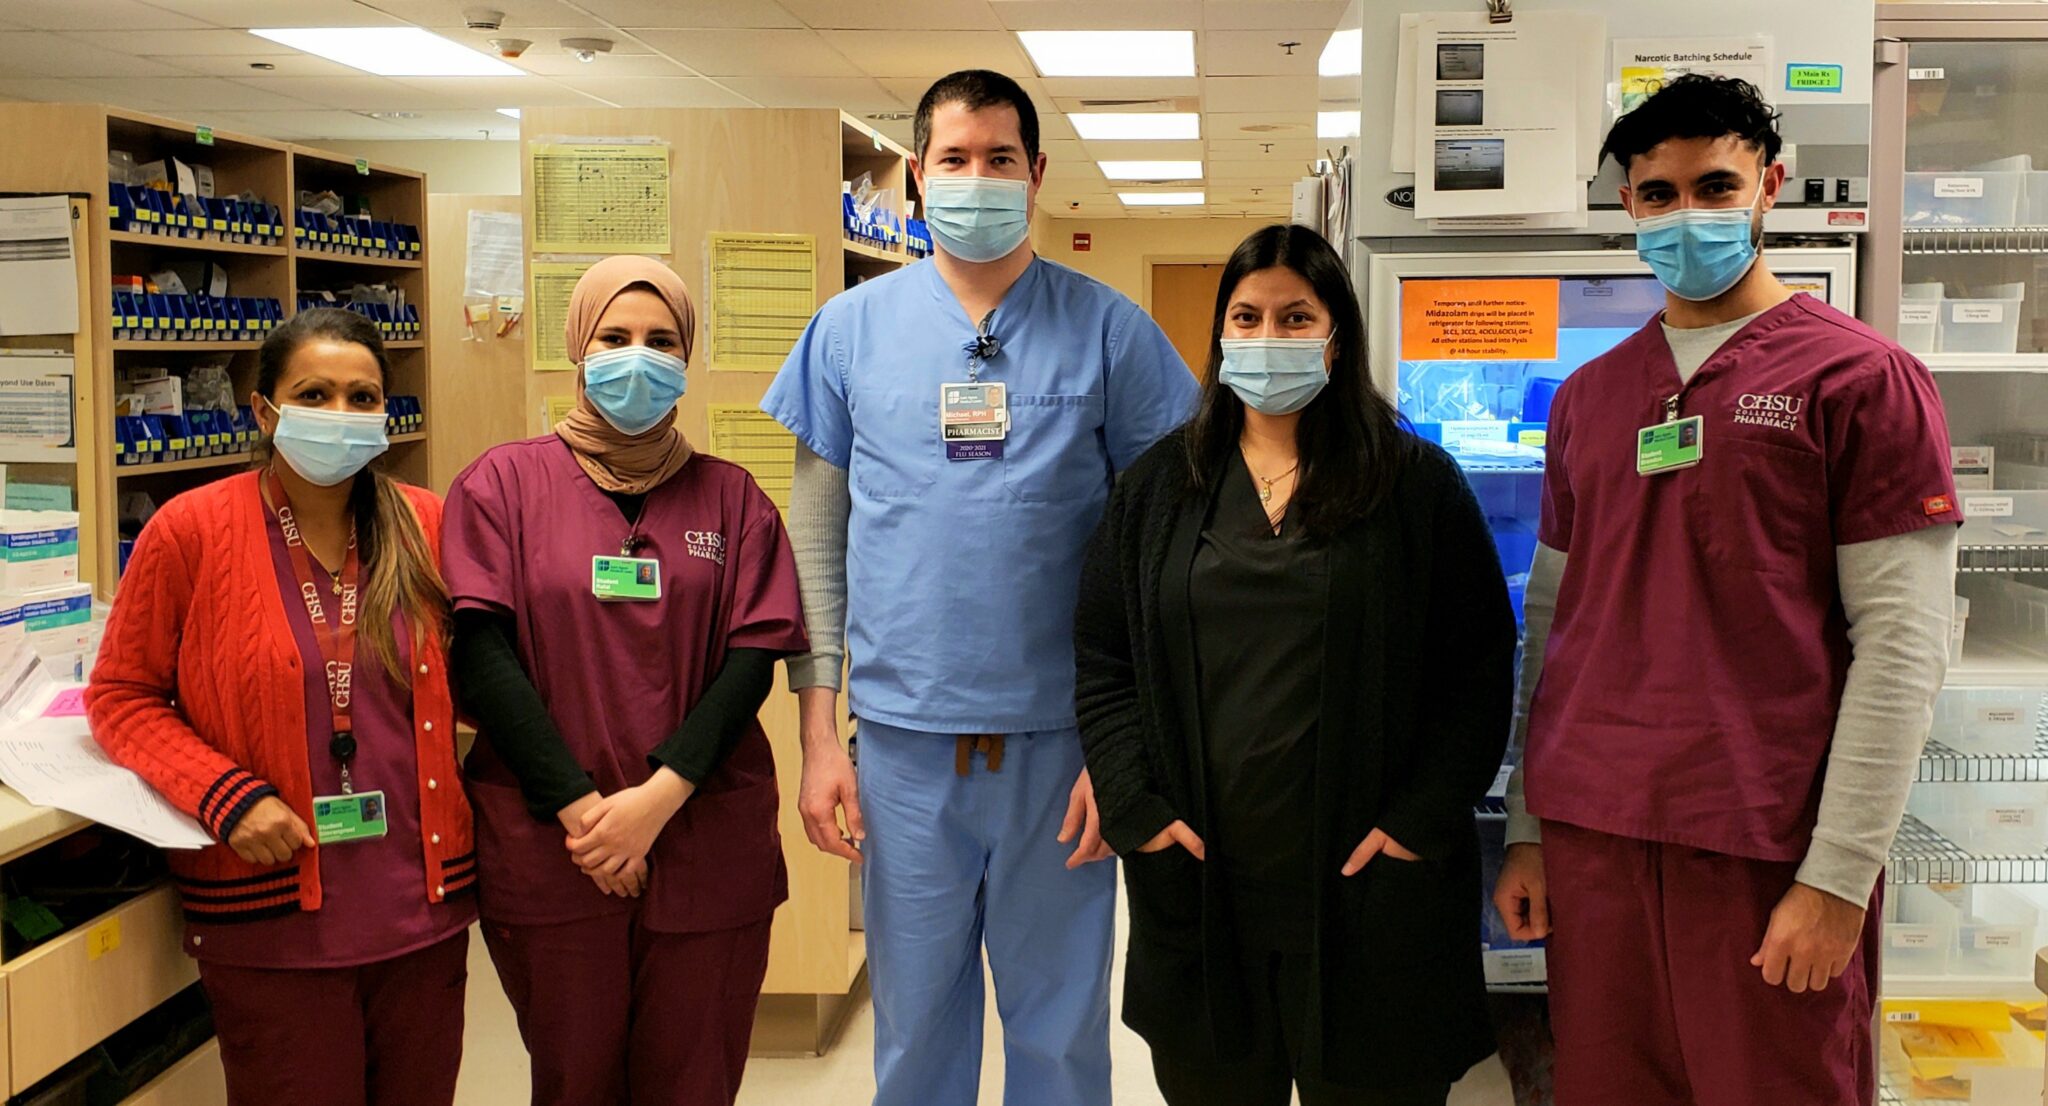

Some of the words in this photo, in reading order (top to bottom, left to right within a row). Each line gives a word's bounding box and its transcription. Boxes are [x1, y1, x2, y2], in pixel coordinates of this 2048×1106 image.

[1635, 54, 1671, 63] Narcotic
[1673, 53, 1710, 63] Batching
[1713, 52, 1752, 61] Schedule
[1507, 310, 1528, 318] placed
[1428, 320, 1464, 328] refrigerator
[1738, 394, 1804, 414] CHSU
[1735, 409, 1780, 418] COLLEGE
[947, 428, 1001, 436] PHARMACIST
[1733, 415, 1797, 431] PHARMACY
[278, 506, 302, 547] CHSU
[685, 530, 726, 552] CHSU
[302, 582, 326, 624] CHSU
[342, 584, 358, 625] CHSU
[336, 660, 352, 708] CHSU
